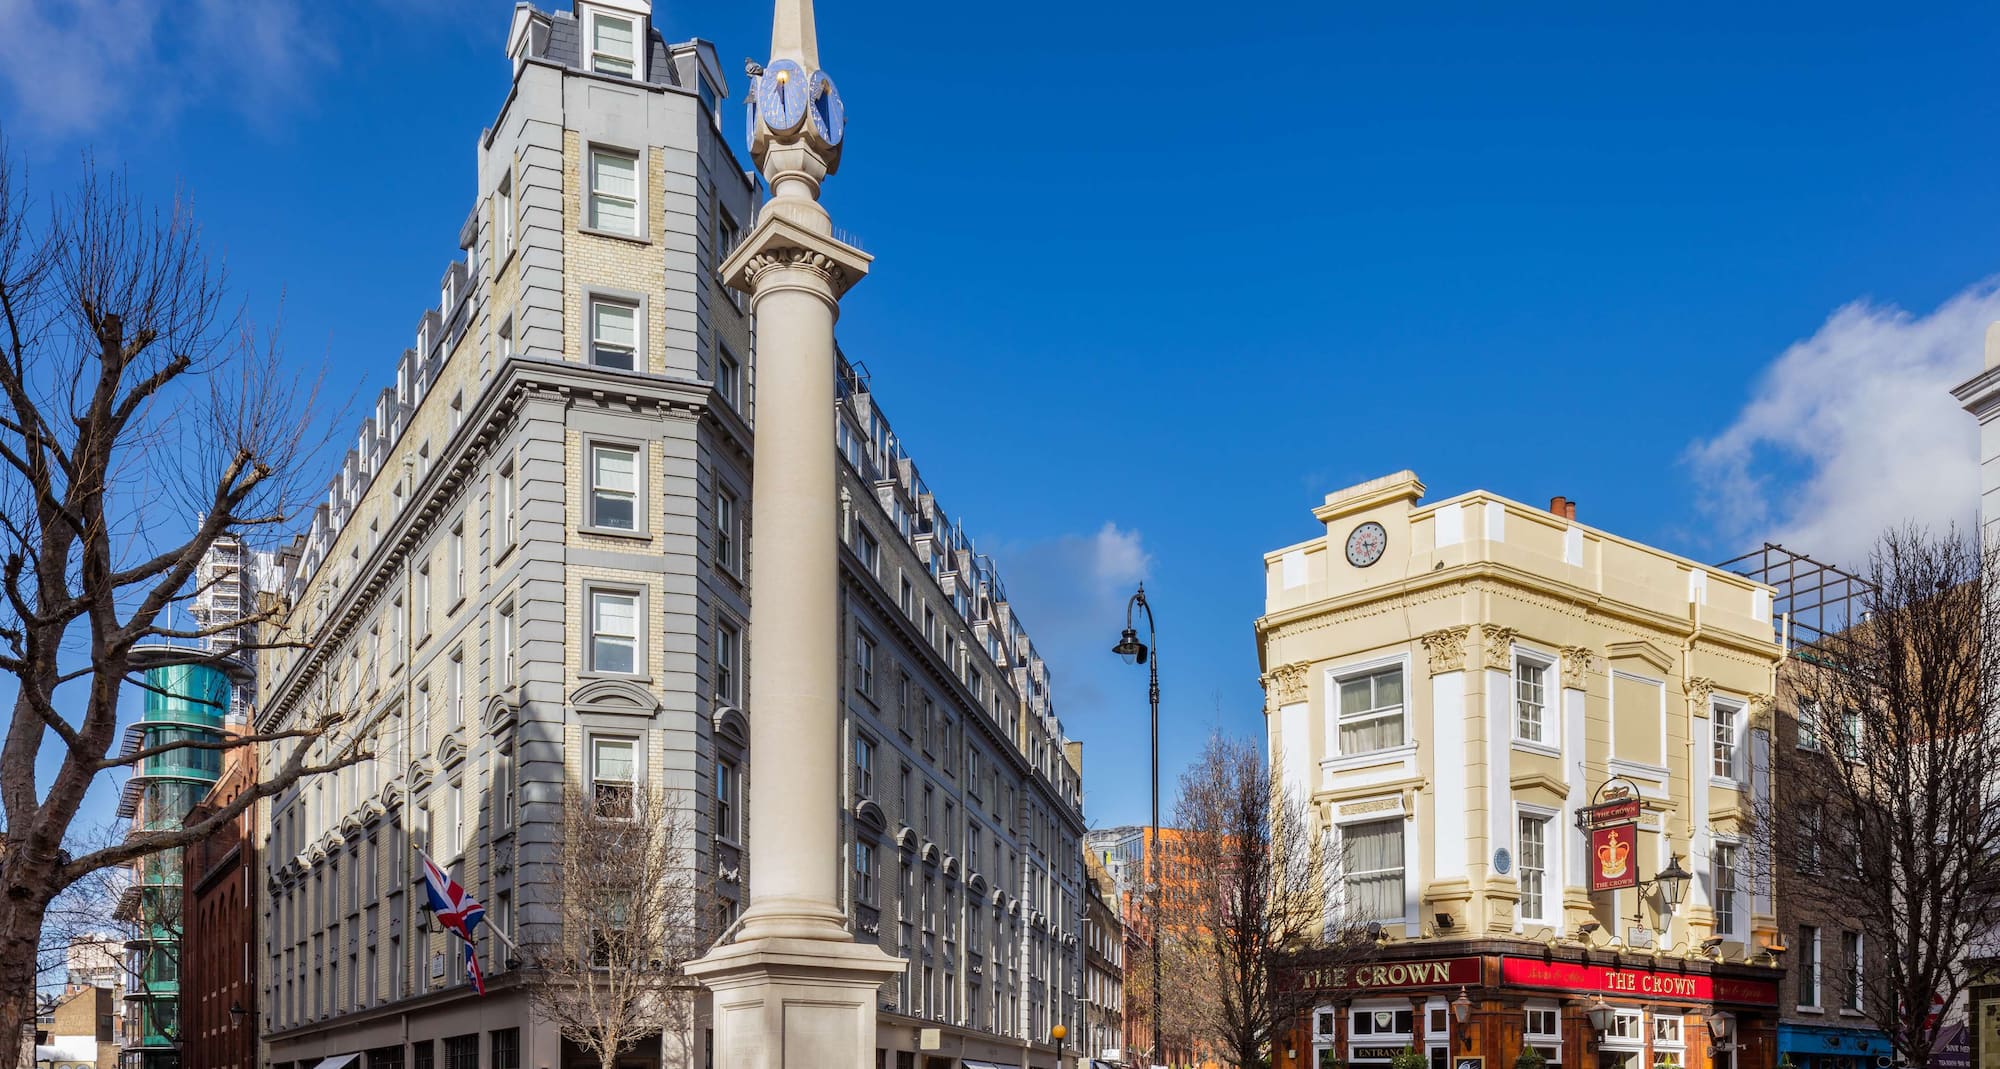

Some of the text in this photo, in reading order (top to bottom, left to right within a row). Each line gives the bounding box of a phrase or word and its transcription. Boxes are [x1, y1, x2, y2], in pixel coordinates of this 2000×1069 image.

[1597, 806, 1636, 819] THE CROWN
[1596, 878, 1633, 889] THE CROWN
[1299, 961, 1452, 989] THE CROWN
[1605, 971, 1636, 991] THE
[1642, 975, 1696, 996] CROWN
[1359, 1048, 1405, 1057] ENTRANC
